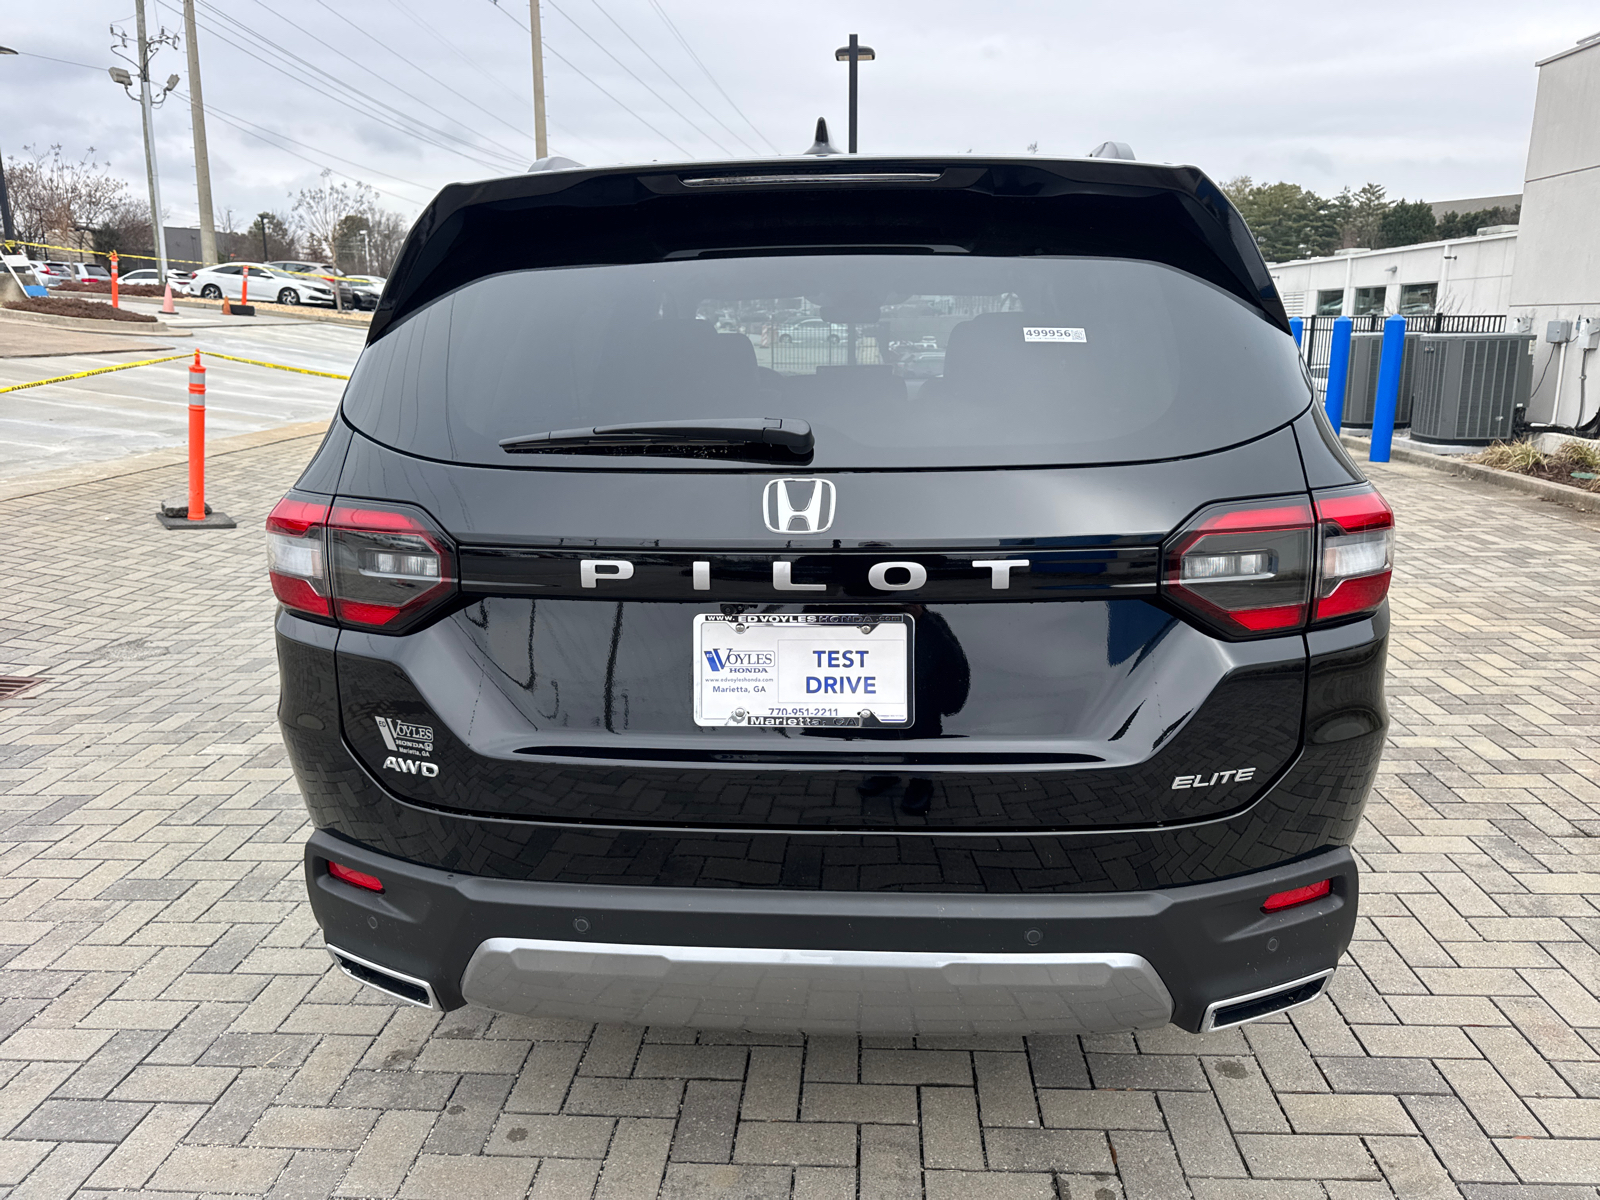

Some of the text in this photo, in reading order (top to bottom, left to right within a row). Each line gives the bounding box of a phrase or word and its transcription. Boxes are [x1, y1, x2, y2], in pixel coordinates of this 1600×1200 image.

[1025, 329, 1071, 337] 499956
[580, 559, 1030, 591] PILOT
[712, 648, 773, 670] VOYLES
[812, 650, 869, 668] TEST
[712, 685, 767, 693] Marietta, GA
[805, 676, 877, 694] DRIVE
[768, 708, 838, 716] 770-951-2211
[386, 718, 433, 740] VOYLES
[395, 739, 425, 749] HONDA
[382, 756, 440, 777] AWD
[1171, 767, 1257, 790] ELITE
